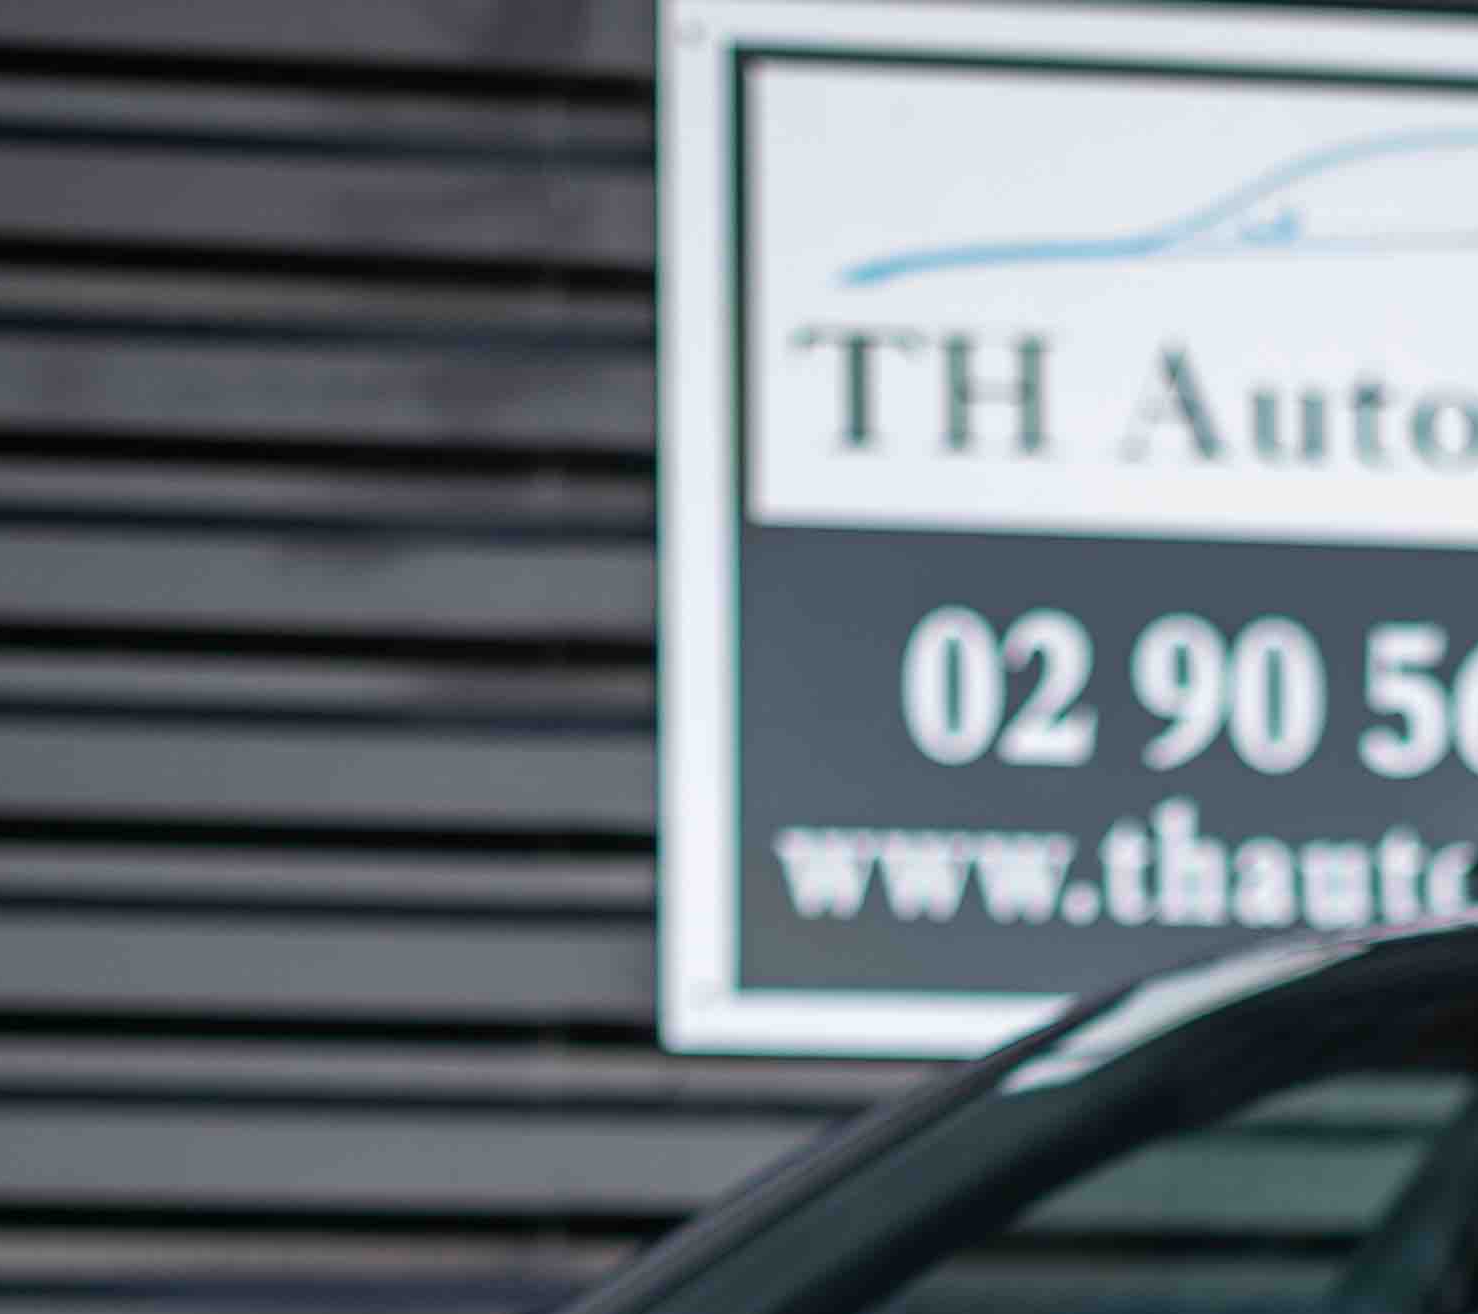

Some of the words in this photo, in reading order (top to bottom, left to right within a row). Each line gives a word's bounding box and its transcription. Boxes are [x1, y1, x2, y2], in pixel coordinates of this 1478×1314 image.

[790, 322, 1056, 458] TH
[899, 603, 1099, 767] 02
[1130, 611, 1326, 775] 90
